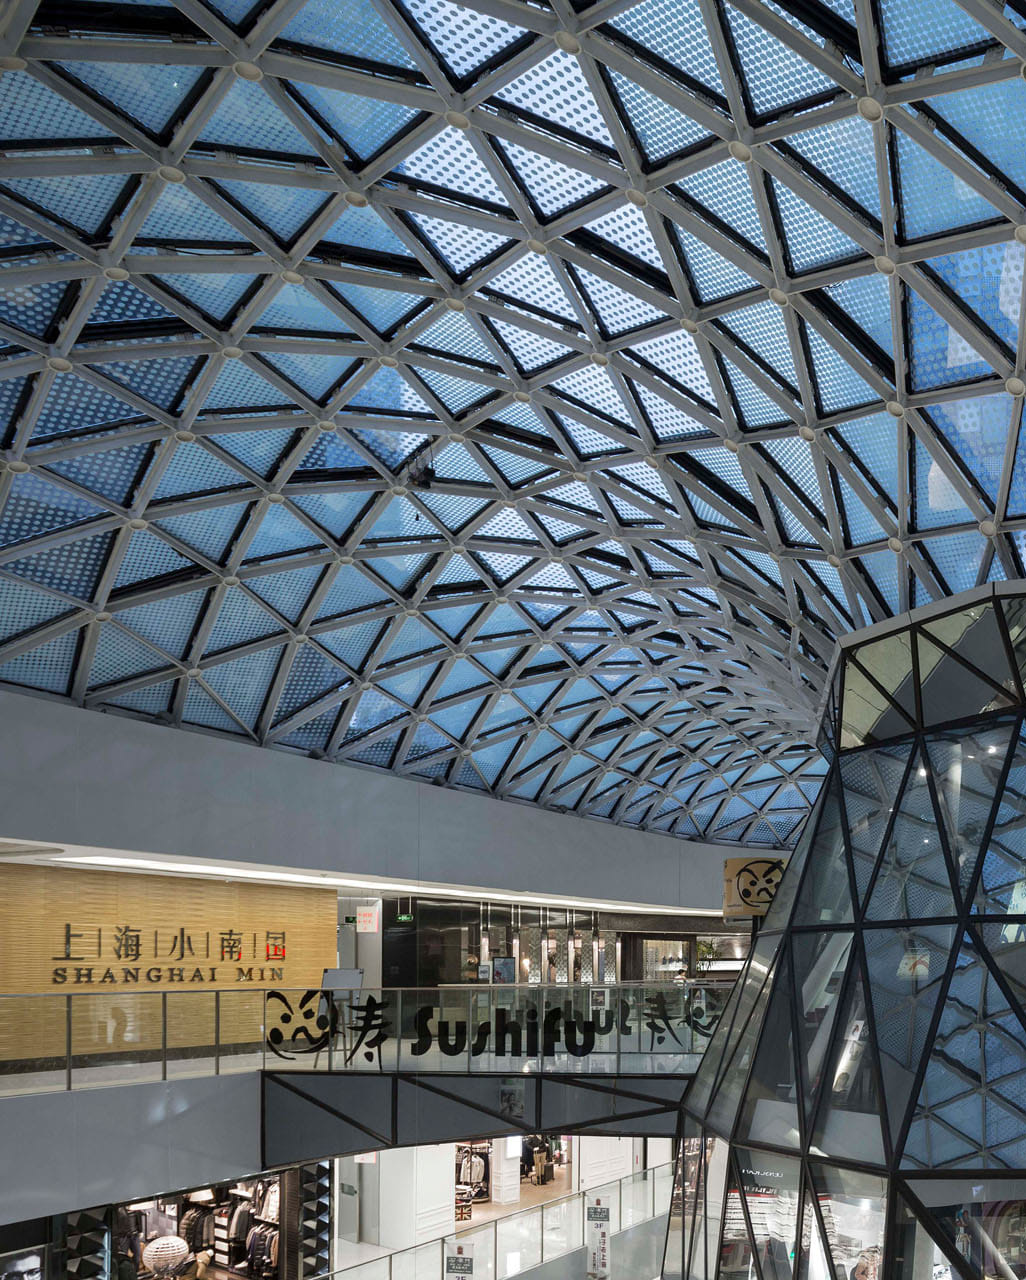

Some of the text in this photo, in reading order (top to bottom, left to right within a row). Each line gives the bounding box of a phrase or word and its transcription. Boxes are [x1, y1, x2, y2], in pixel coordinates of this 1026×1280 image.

[52, 967, 284, 984] SHANGHAI MIN
[411, 1006, 597, 1058] Sushifu
